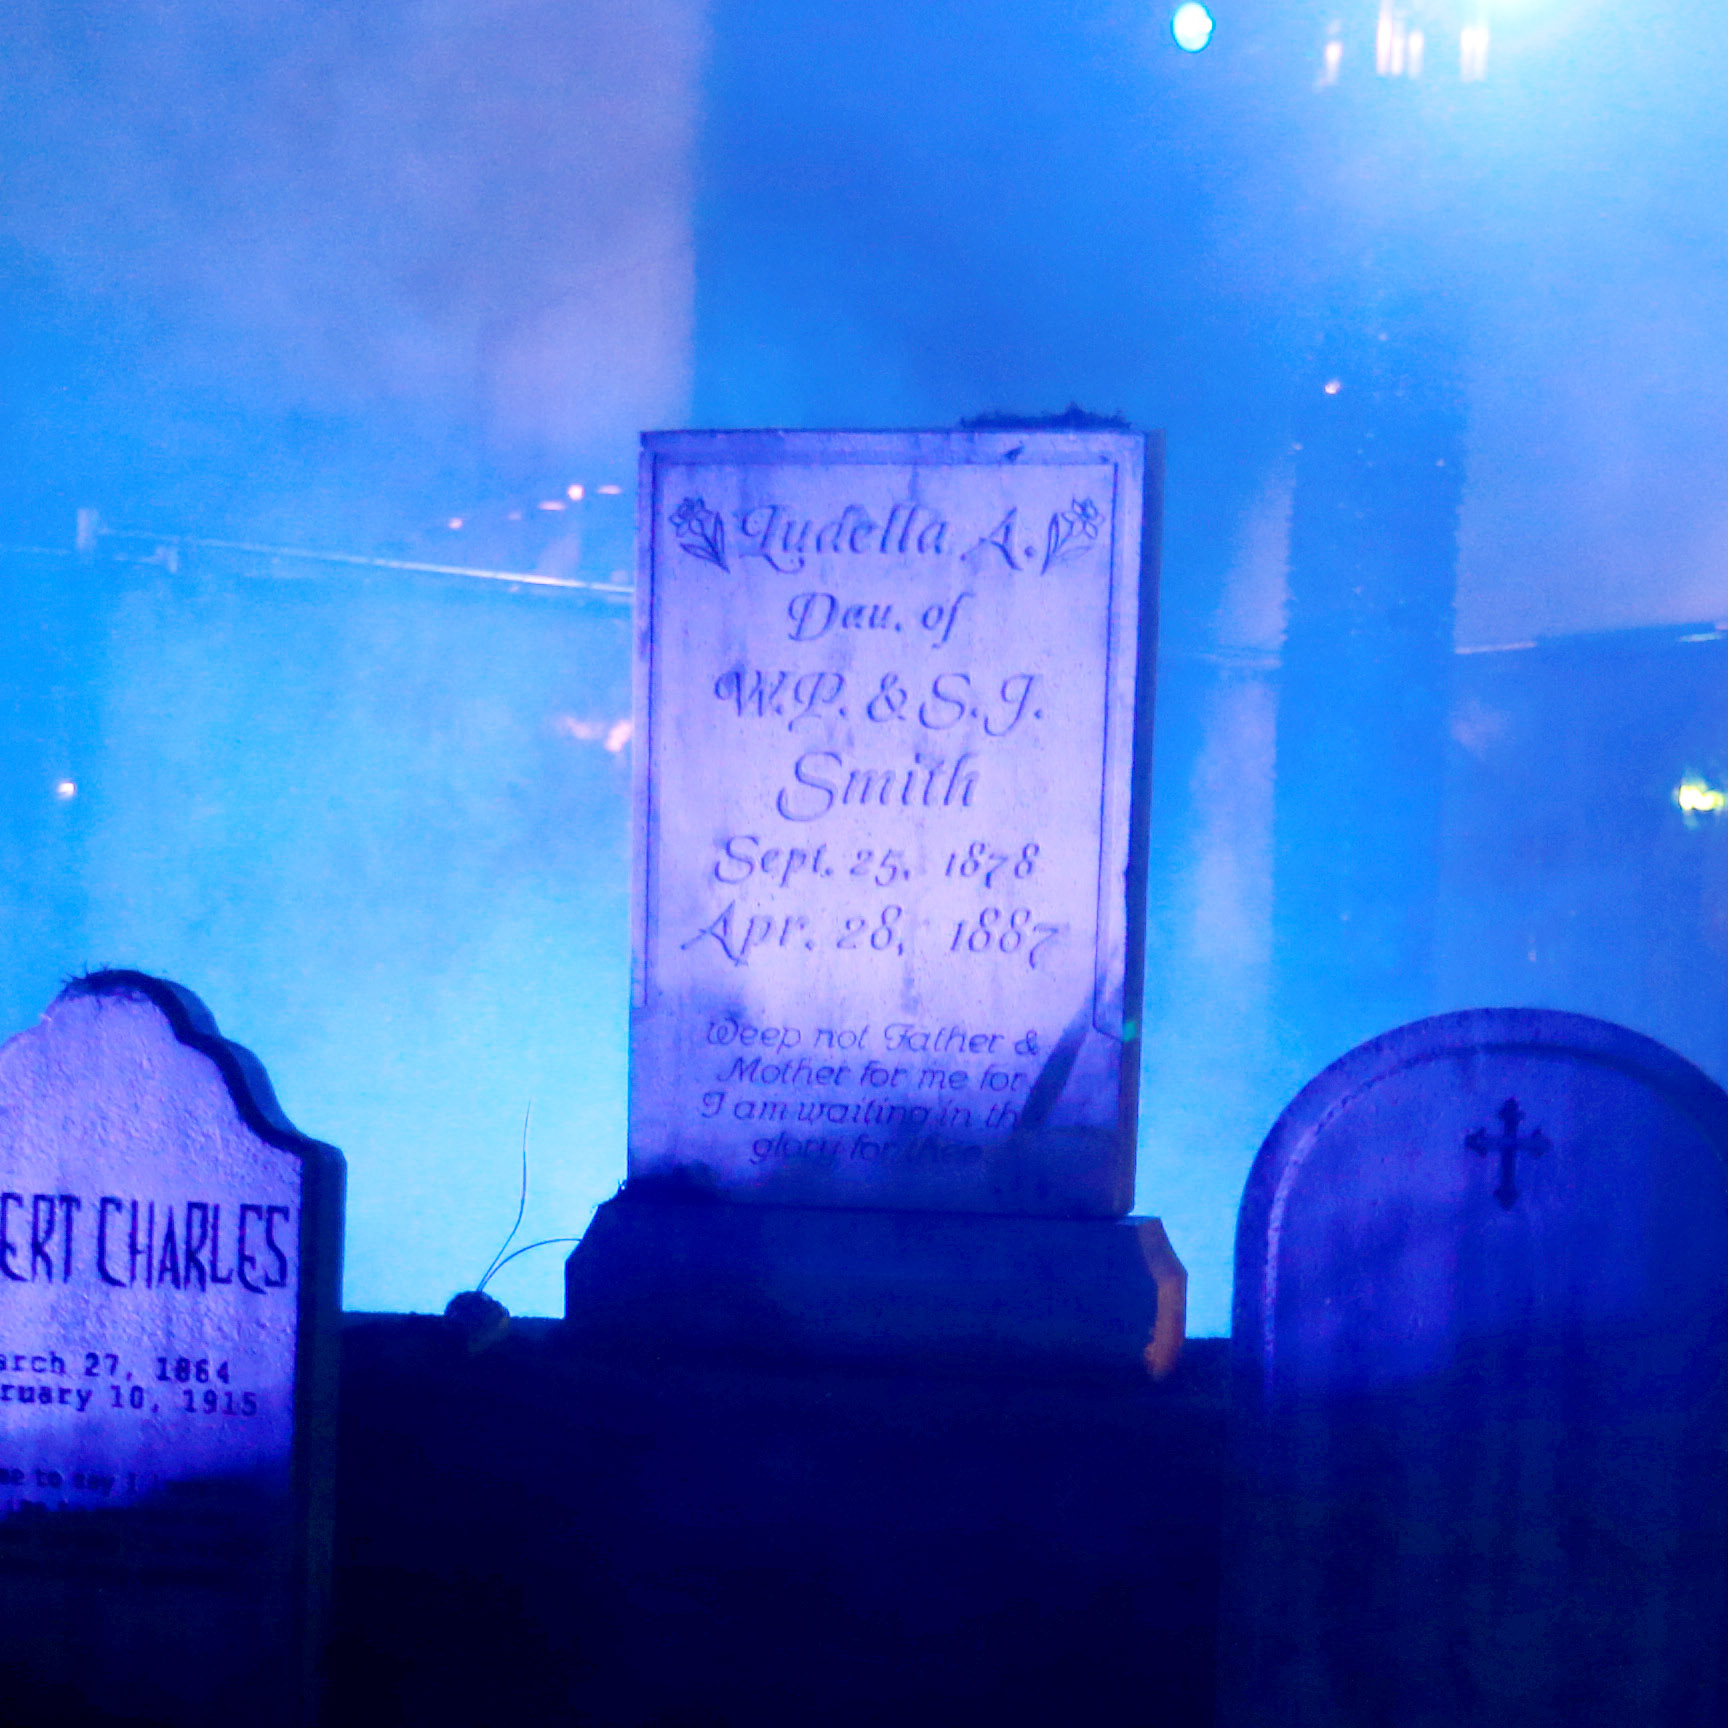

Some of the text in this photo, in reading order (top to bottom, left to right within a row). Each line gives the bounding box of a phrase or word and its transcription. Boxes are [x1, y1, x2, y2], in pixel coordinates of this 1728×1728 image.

[786, 591, 975, 650] Dau. of
[866, 671, 909, 723] &
[776, 751, 981, 822] Smith
[713, 833, 835, 890] Sept.
[944, 840, 1041, 890] 1878
[679, 899, 816, 967] Apr.
[949, 906, 1064, 970] 1887
[706, 1016, 1040, 1056] Weep not Father &
[716, 1056, 1028, 1092] Mother for me for
[733, 1099, 789, 1122] am
[797, 1096, 930, 1130] waiting
[939, 1099, 973, 1128] in
[96, 1195, 291, 1295] CHARLES
[154, 1355, 231, 1385] 1864
[181, 1387, 259, 1418] 1915
[35, 1465, 64, 1489] to
